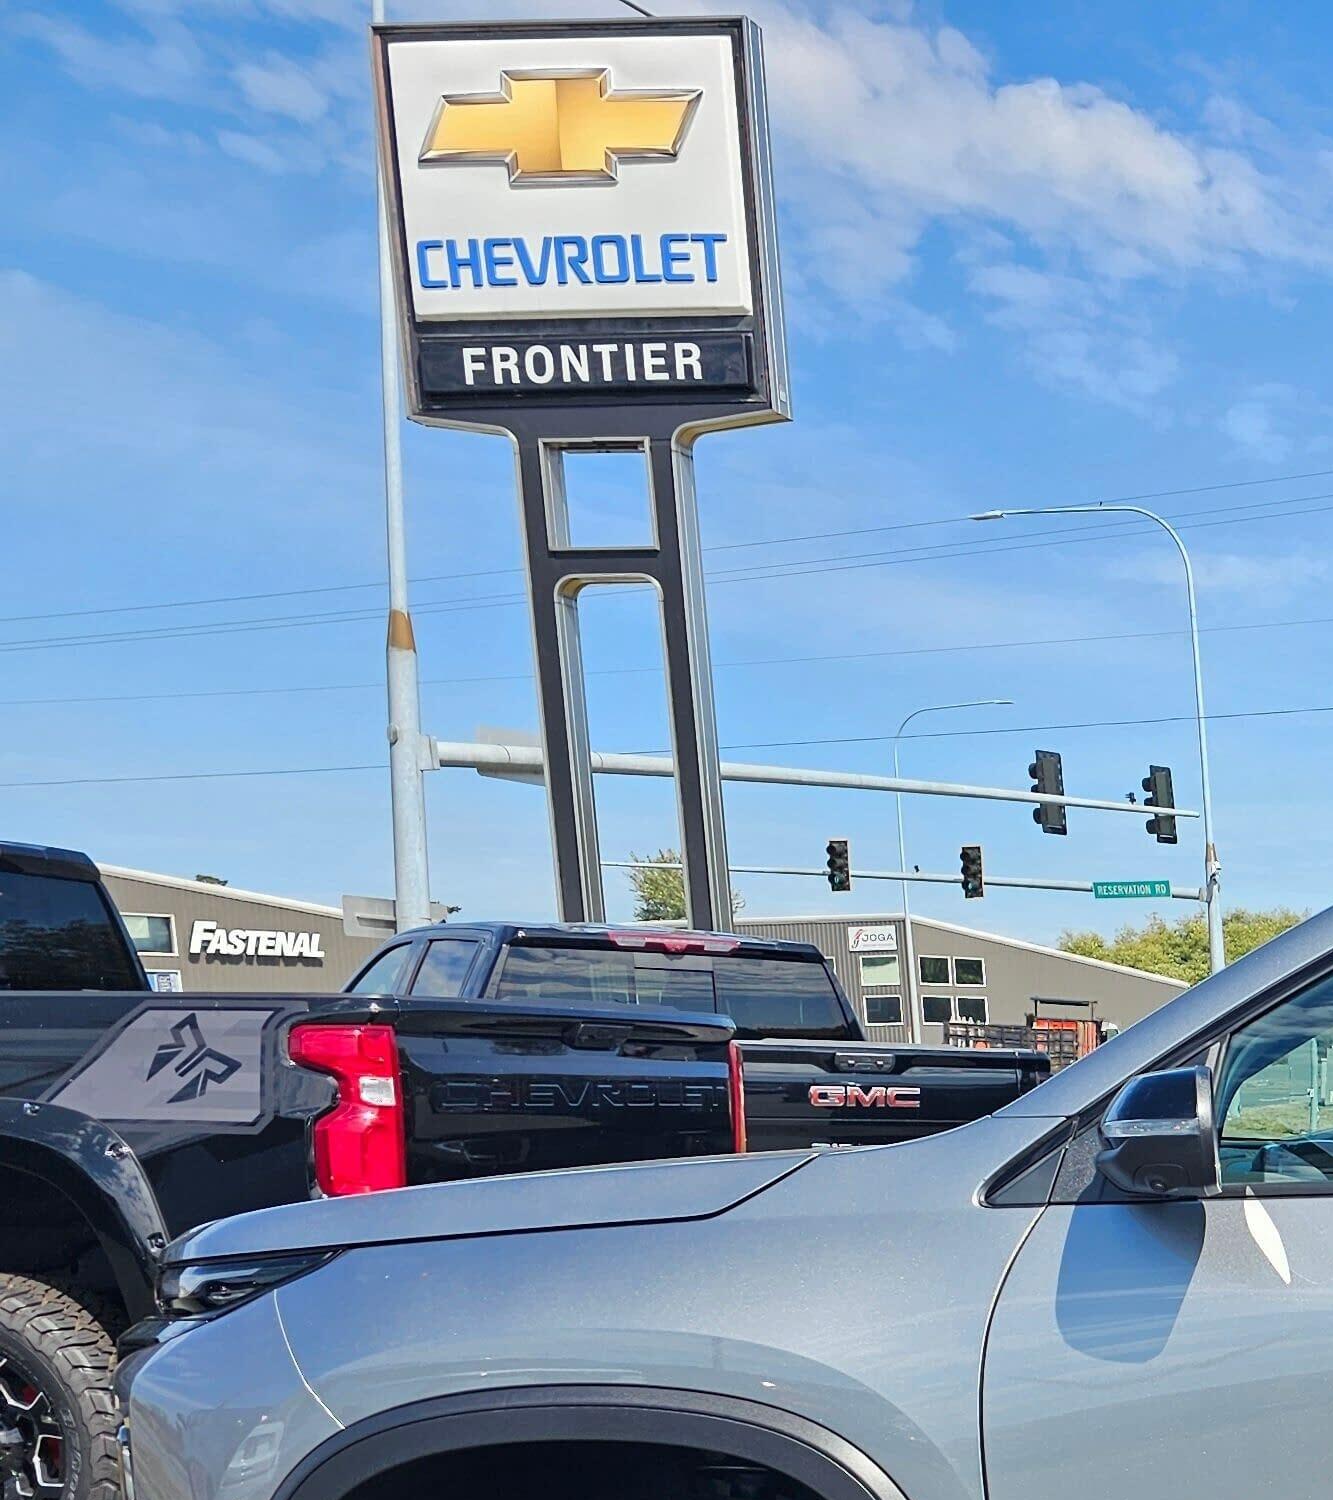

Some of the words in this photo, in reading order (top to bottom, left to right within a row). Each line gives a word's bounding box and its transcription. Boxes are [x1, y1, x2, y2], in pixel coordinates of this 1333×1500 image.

[416, 233, 727, 288] CHEVROLET
[462, 342, 703, 386] FRONTIER
[1097, 884, 1151, 896] RESERVATION
[1155, 883, 1167, 894] RD
[189, 920, 325, 958] FASTENAL
[808, 1085, 921, 1108] GMC
